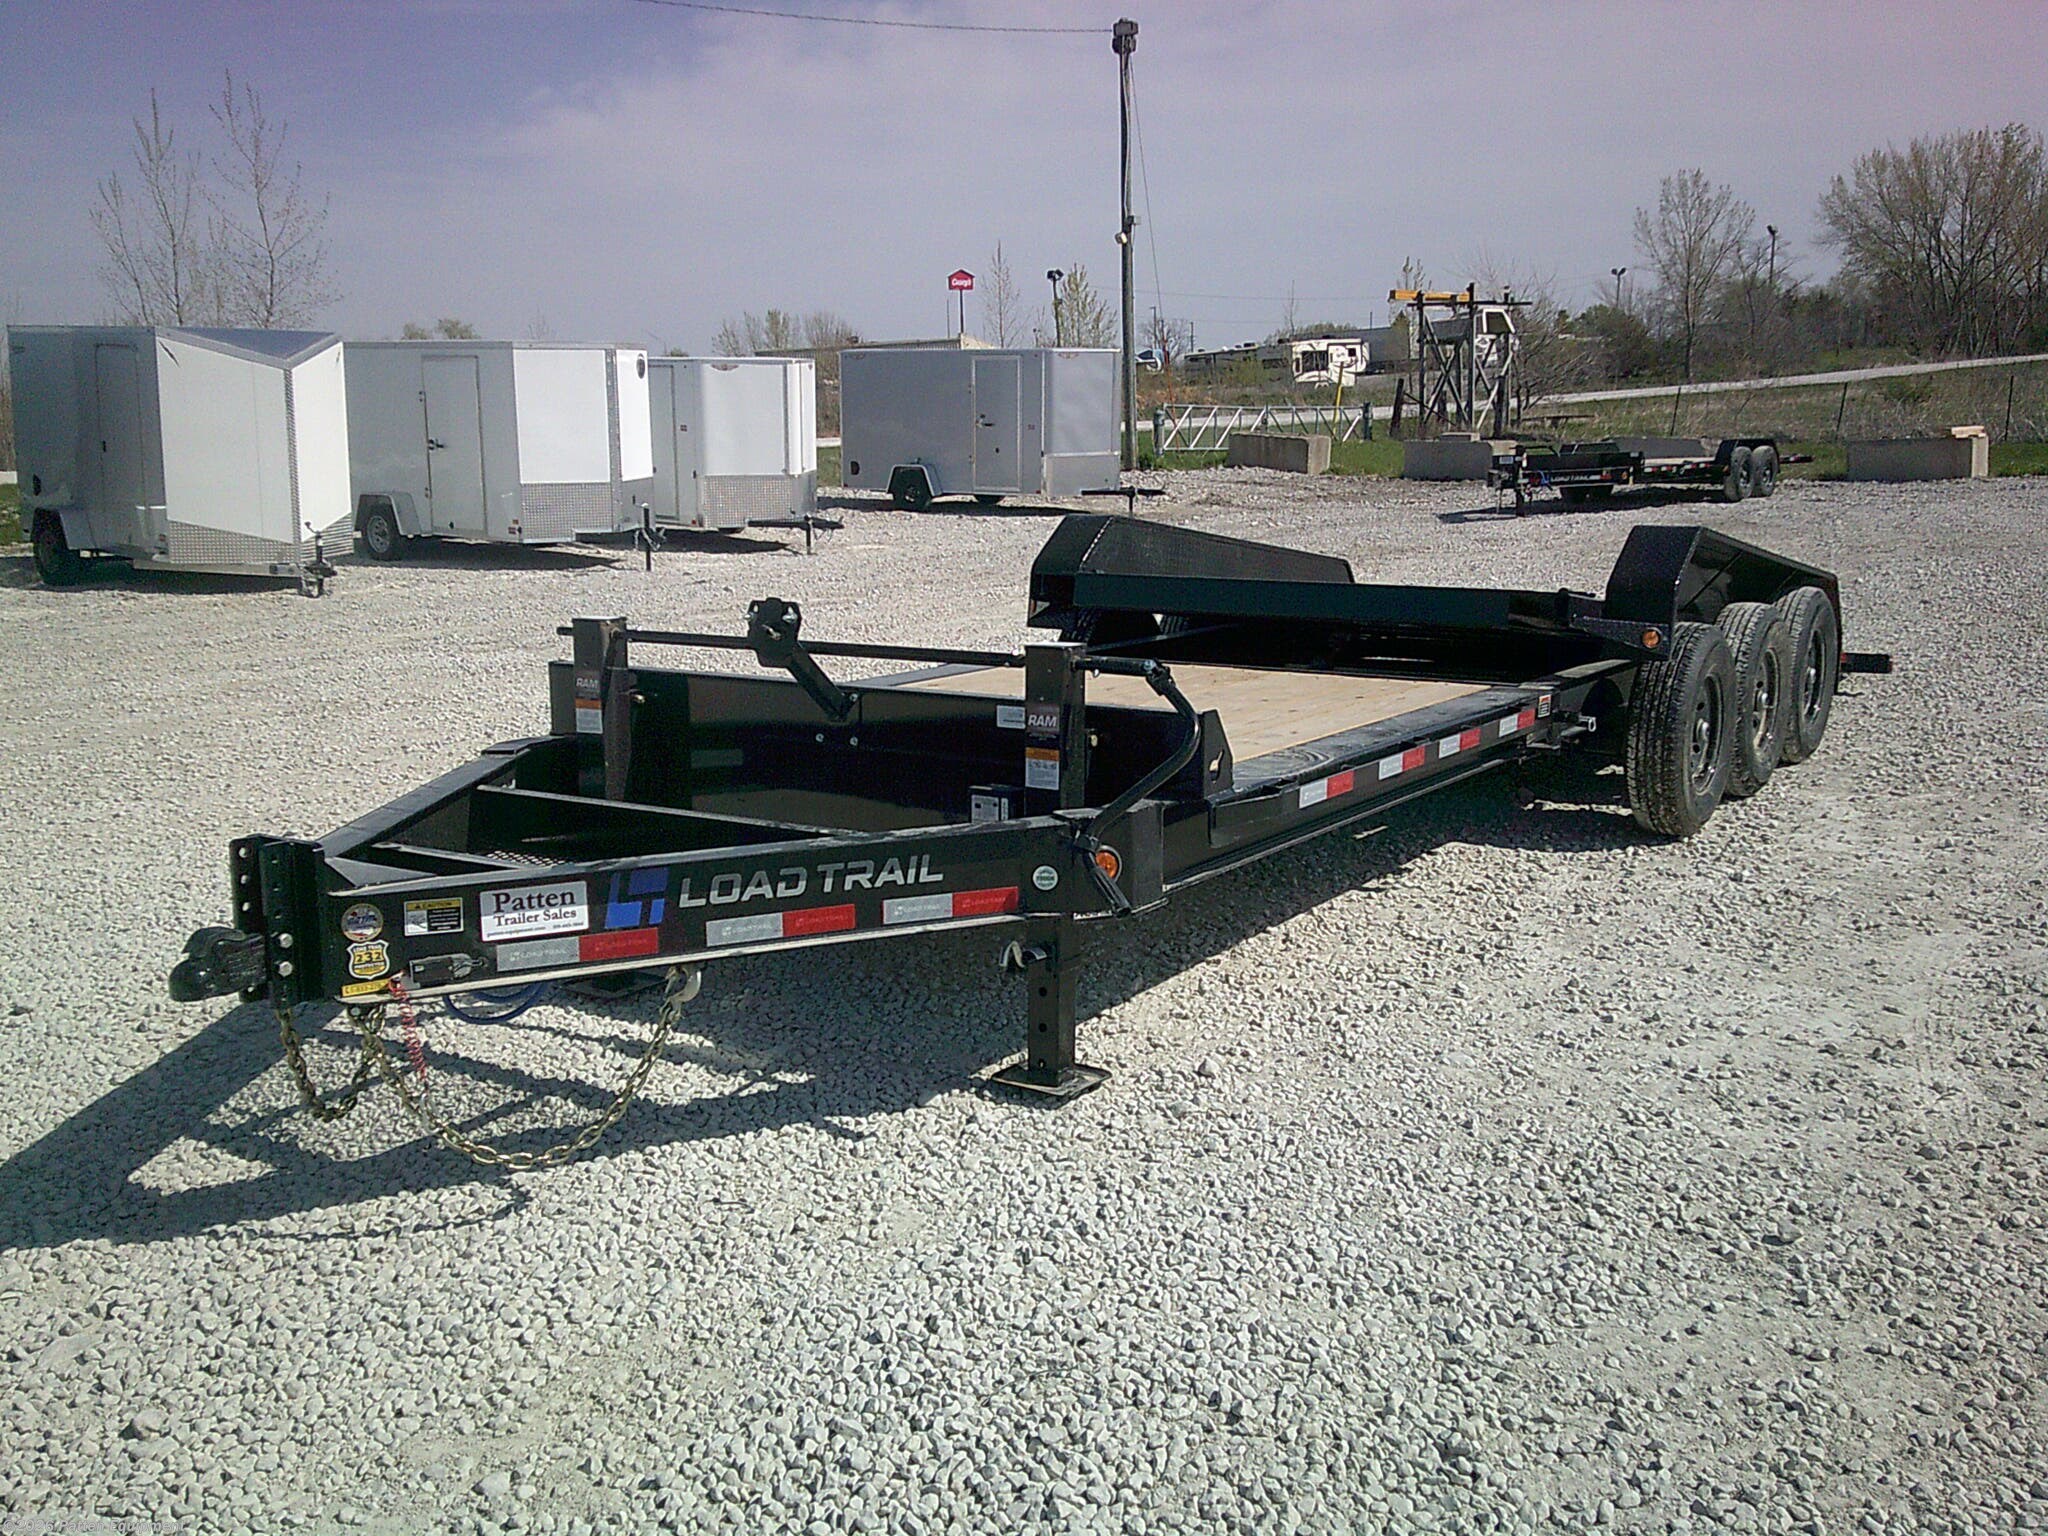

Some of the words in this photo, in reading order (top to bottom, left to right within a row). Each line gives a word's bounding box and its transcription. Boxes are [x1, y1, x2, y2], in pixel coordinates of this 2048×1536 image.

[1028, 714, 1057, 727] RAM
[679, 866, 808, 908] LOAD
[817, 854, 944, 893] TRAIL
[492, 890, 577, 914] Patten
[493, 911, 540, 927] Trailer
[543, 908, 577, 922] Sales
[356, 951, 381, 963] 232
